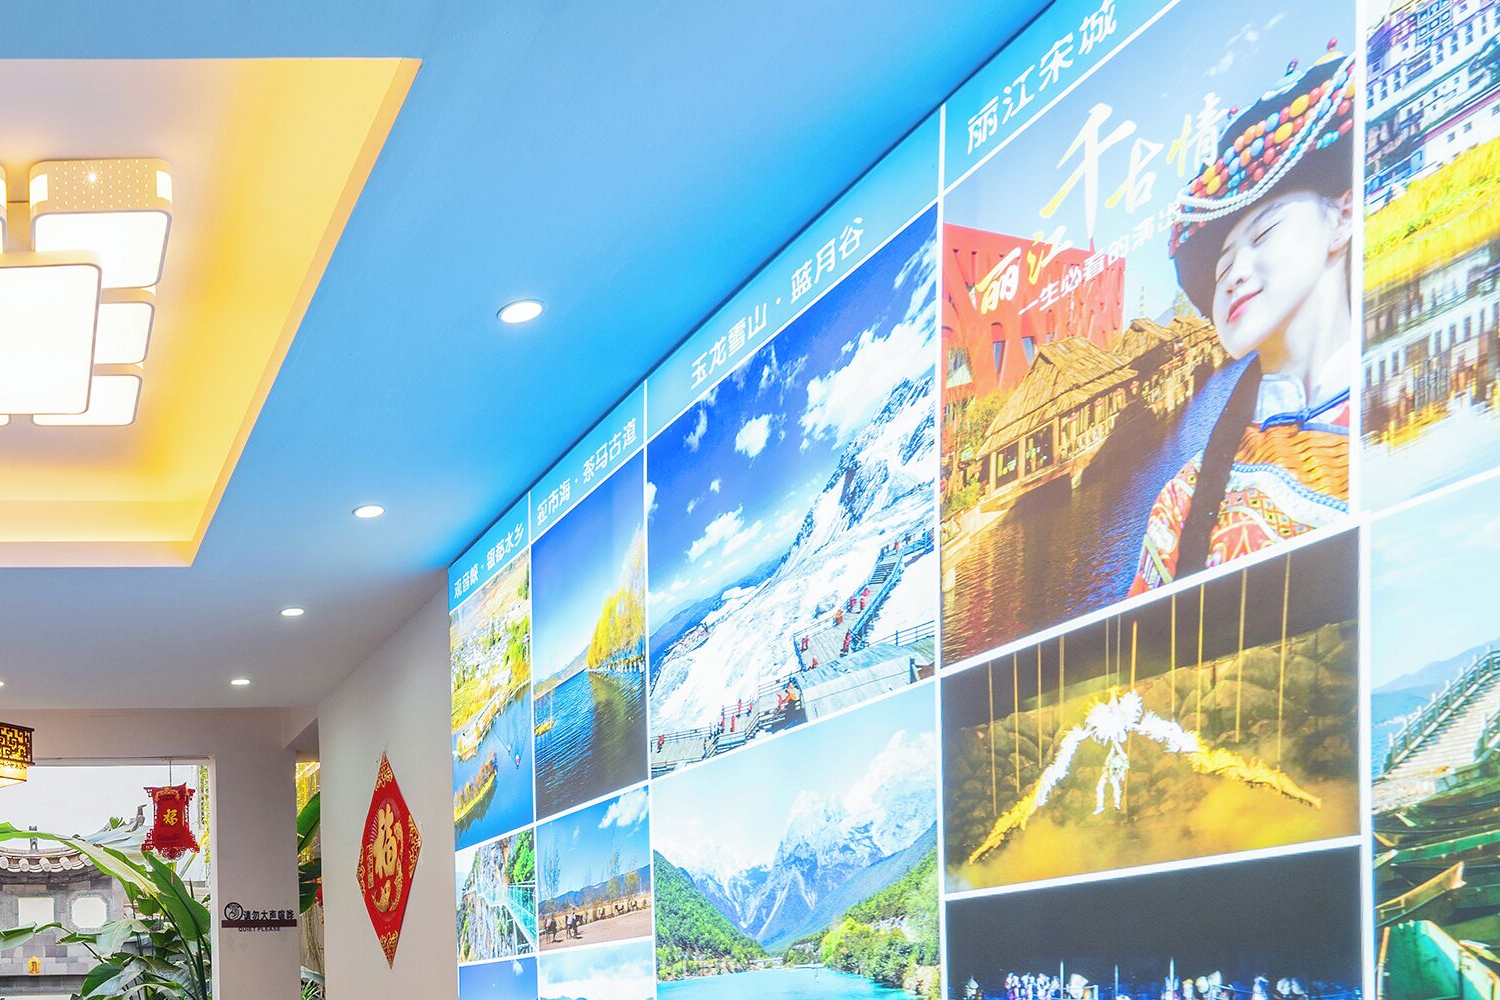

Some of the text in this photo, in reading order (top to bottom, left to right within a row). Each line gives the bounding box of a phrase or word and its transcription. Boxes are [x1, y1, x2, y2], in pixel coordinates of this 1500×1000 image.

[967, 0, 1117, 155] 丽江宋城
[976, 224, 1074, 315] 丽江
[243, 909, 295, 920] 请勿大声喧哗
